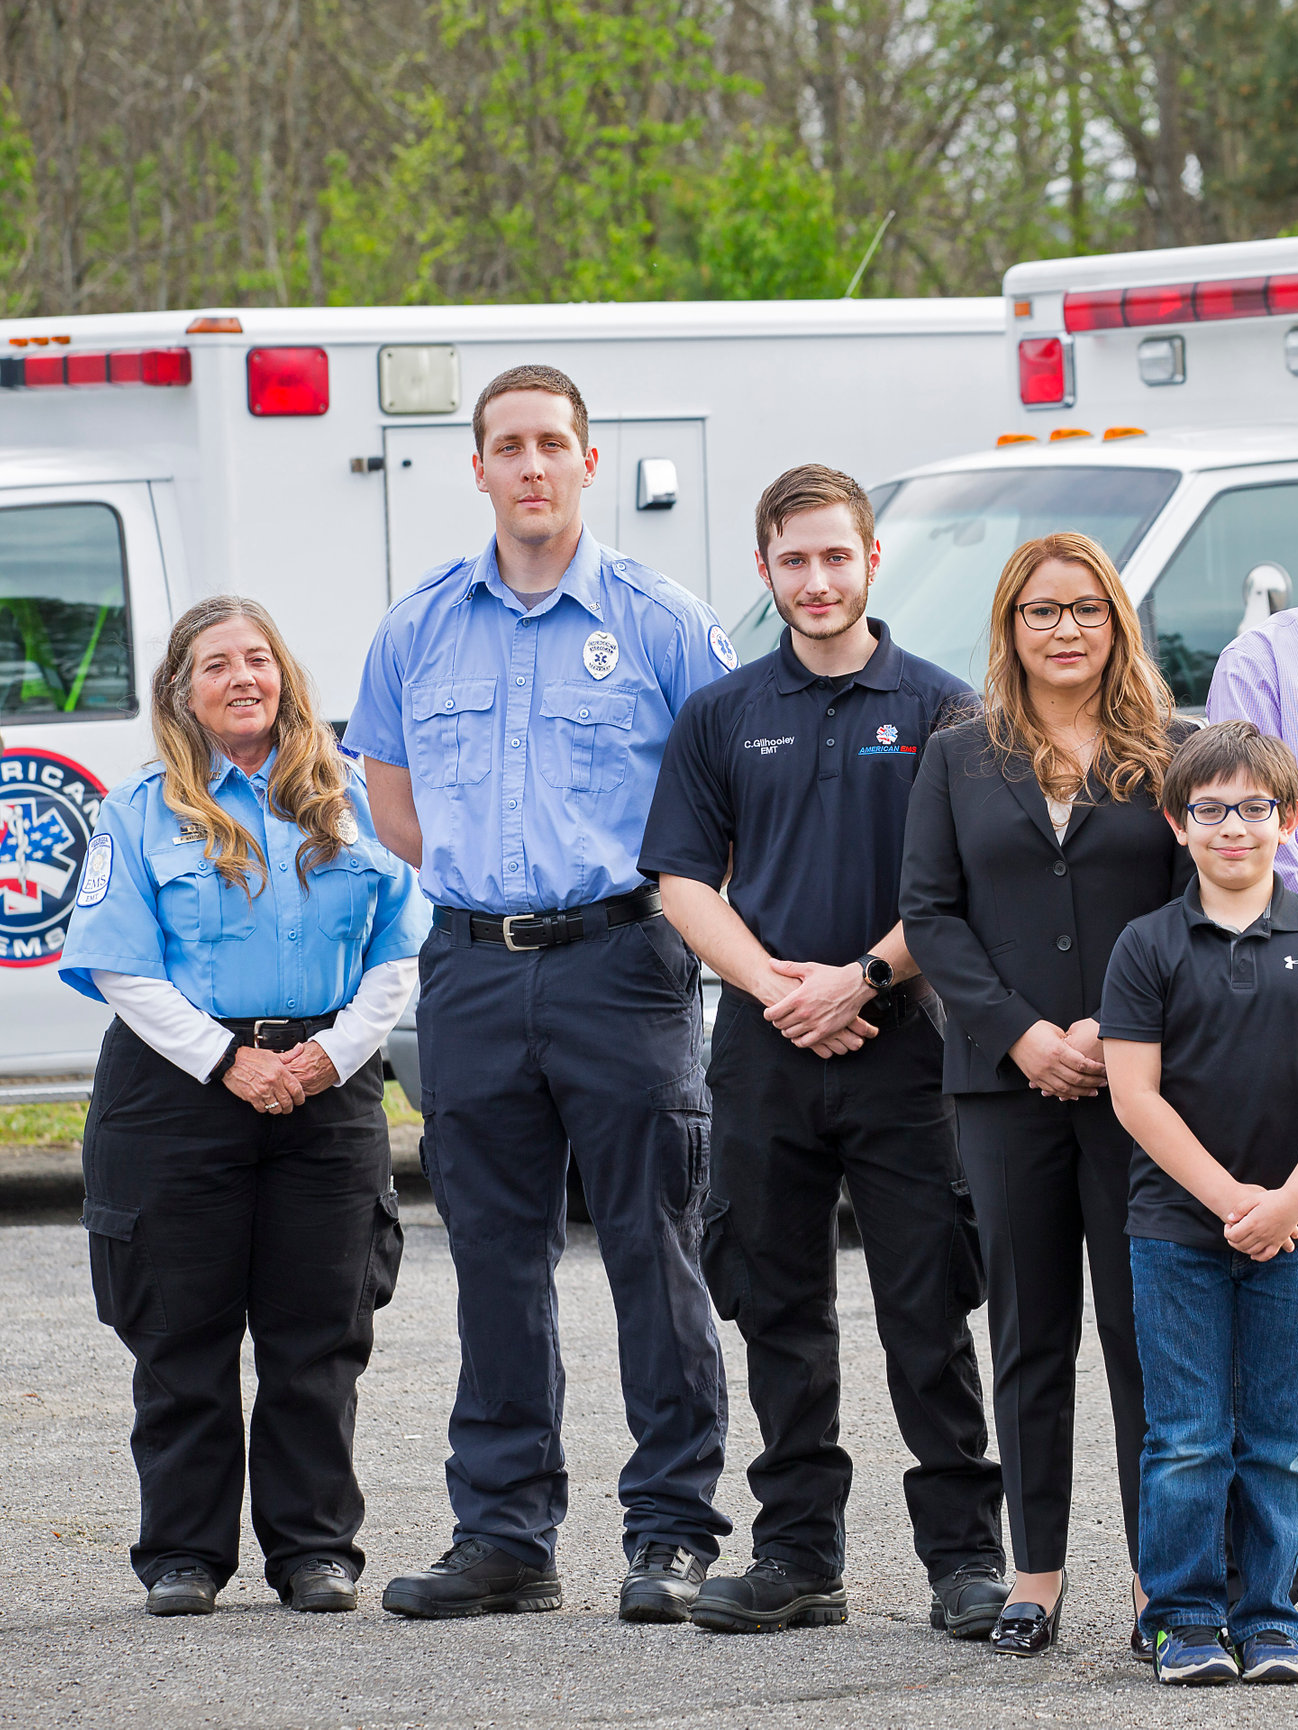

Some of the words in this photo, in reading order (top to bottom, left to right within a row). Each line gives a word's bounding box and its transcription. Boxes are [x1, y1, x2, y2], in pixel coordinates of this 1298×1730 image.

[760, 745, 778, 755] EMT
[858, 744, 900, 754] AMERICAN
[84, 874, 107, 890] EMS
